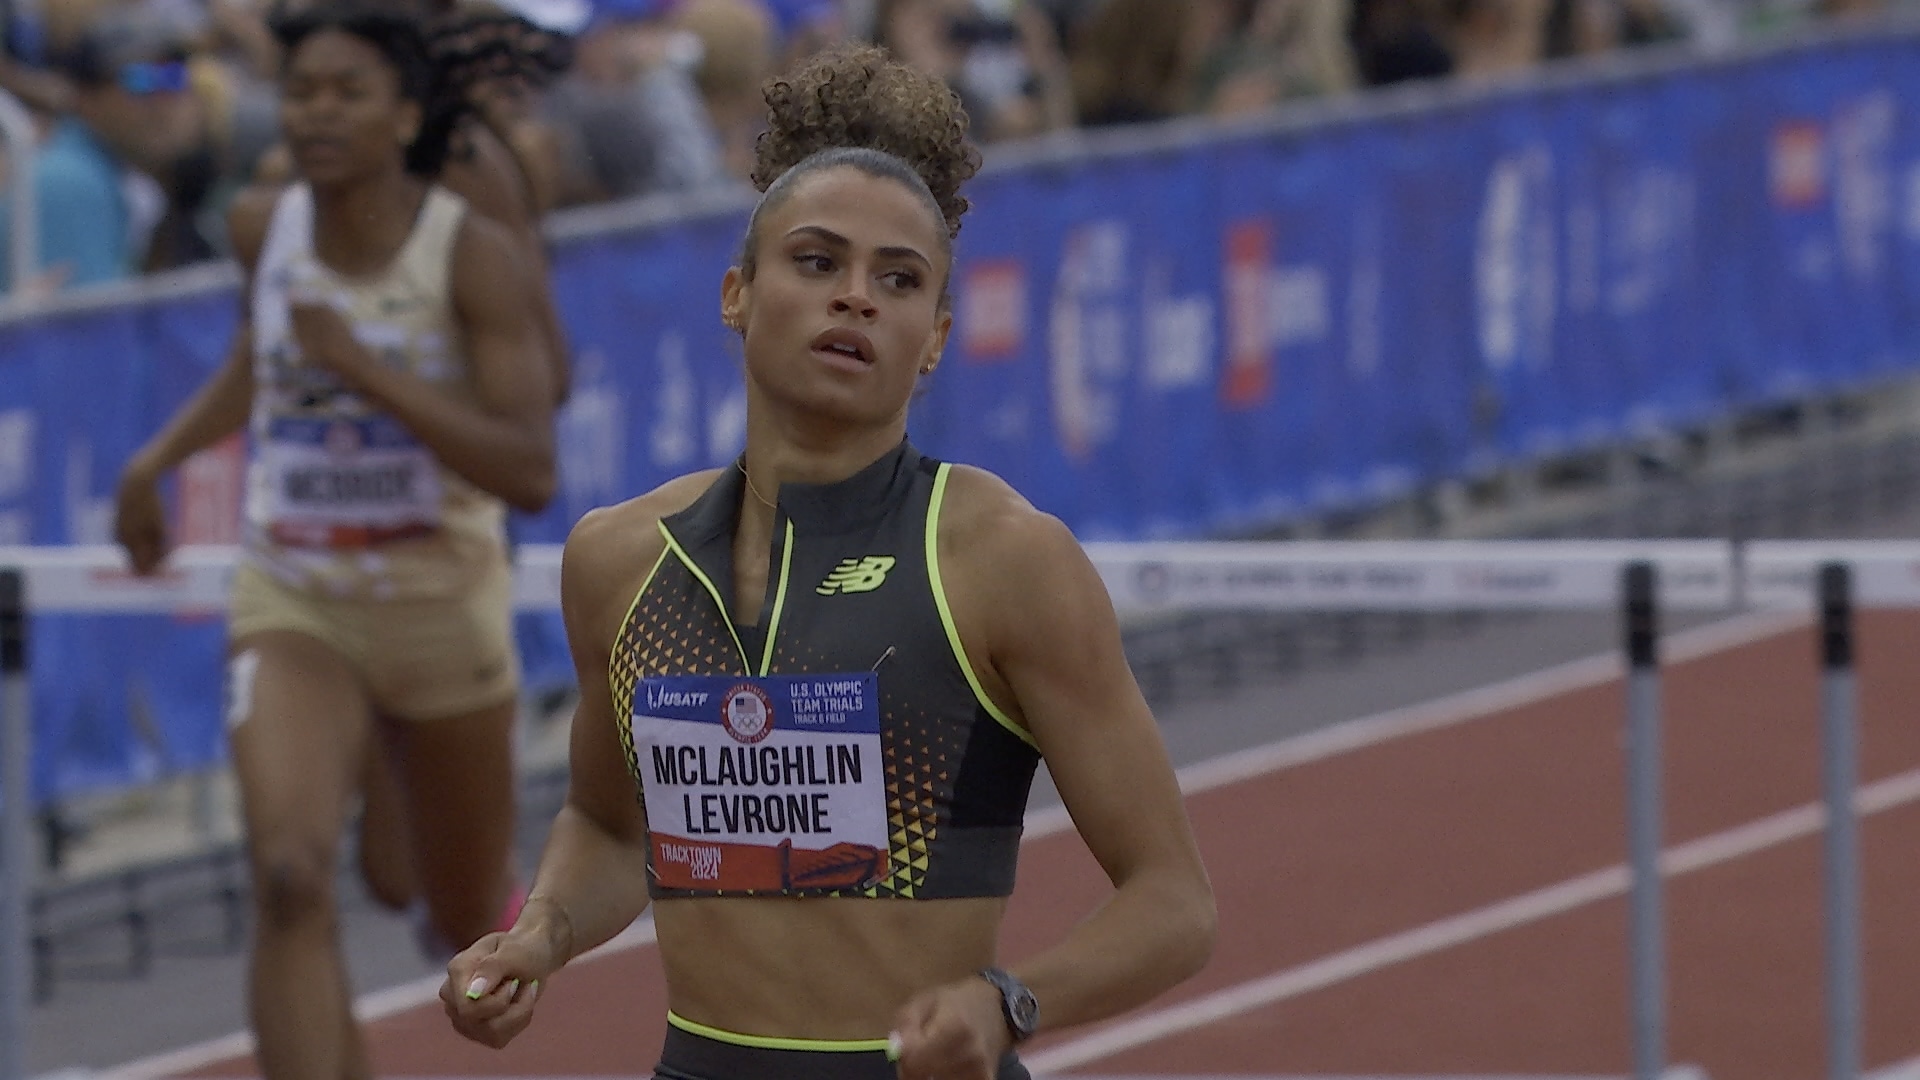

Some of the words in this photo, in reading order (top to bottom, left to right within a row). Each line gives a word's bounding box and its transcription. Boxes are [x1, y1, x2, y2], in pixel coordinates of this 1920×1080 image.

[790, 682, 812, 698] U.S.
[814, 680, 862, 698] OLYMPIC
[663, 692, 709, 707] USATF
[791, 697, 821, 713] TEAM
[823, 695, 863, 712] TRIALS
[794, 712, 817, 724] TRACK
[825, 711, 846, 724] FIELD
[652, 743, 862, 787] MCLAUGHLIN
[683, 793, 832, 834] LEVRONE
[660, 843, 722, 865] TRACKTOWN
[690, 861, 719, 880] 2024
